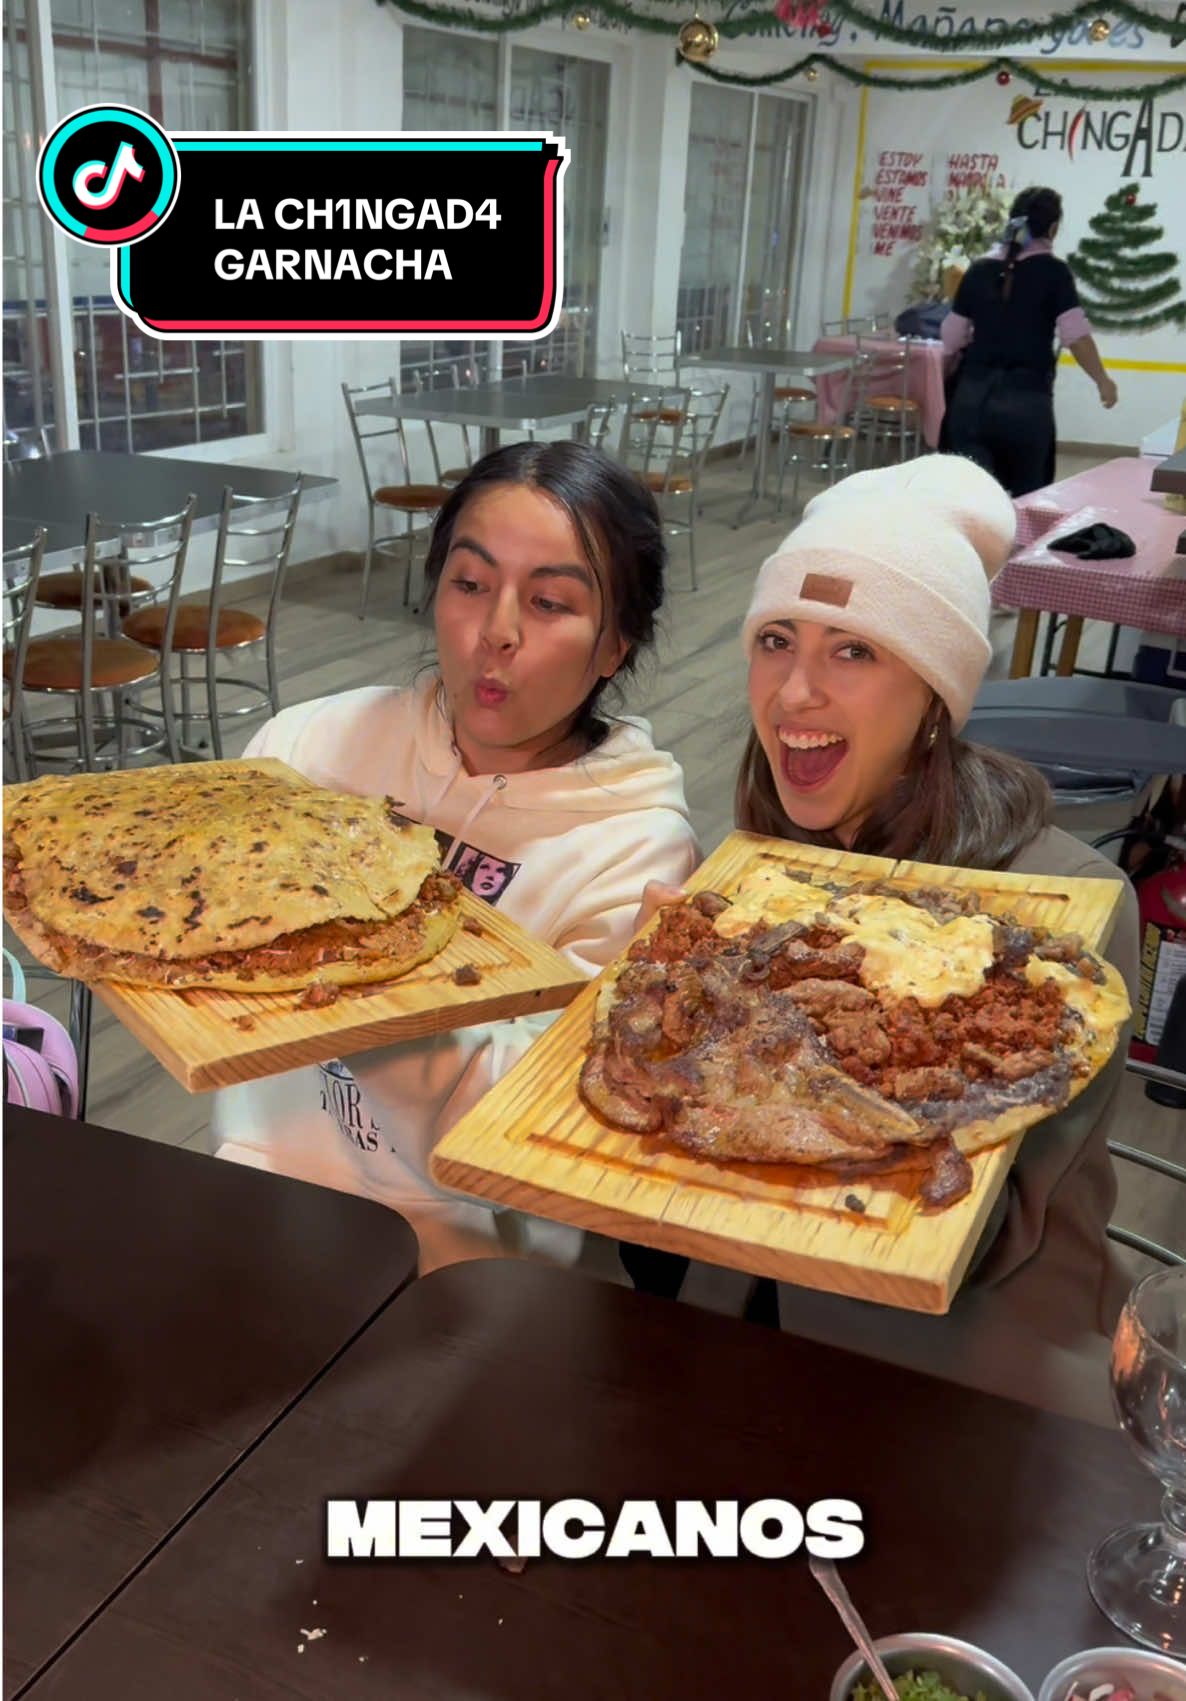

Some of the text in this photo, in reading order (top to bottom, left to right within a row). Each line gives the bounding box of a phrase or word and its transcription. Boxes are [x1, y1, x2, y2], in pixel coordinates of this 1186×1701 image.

[1017, 96, 1186, 177] CHINGAD
[878, 151, 923, 168] ESTOY
[948, 153, 999, 171] HASTA
